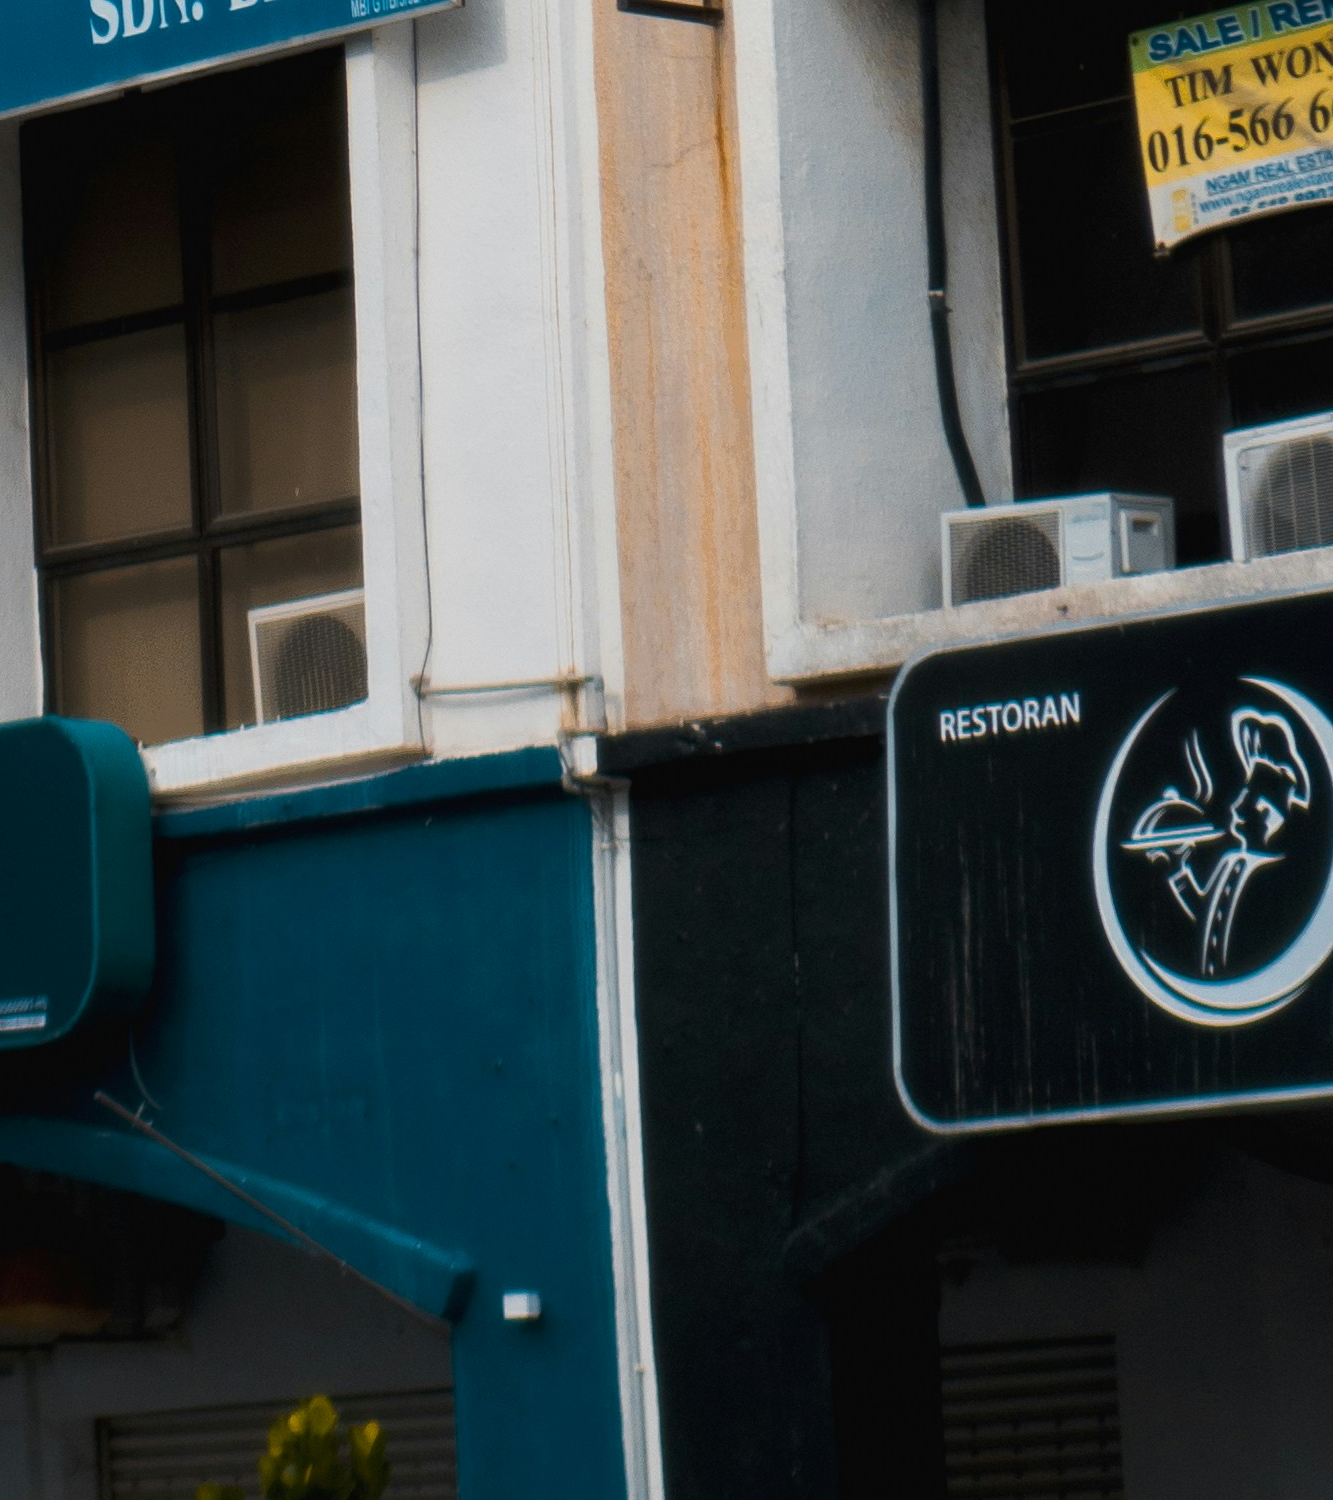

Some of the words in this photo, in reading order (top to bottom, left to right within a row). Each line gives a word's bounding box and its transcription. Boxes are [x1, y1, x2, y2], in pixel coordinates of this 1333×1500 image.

[1148, 13, 1245, 63] SALE
[1164, 63, 1235, 109] TIM
[1147, 96, 1296, 173] 016-566
[1253, 159, 1291, 181] REAL
[938, 692, 1082, 744] RESTORAN
